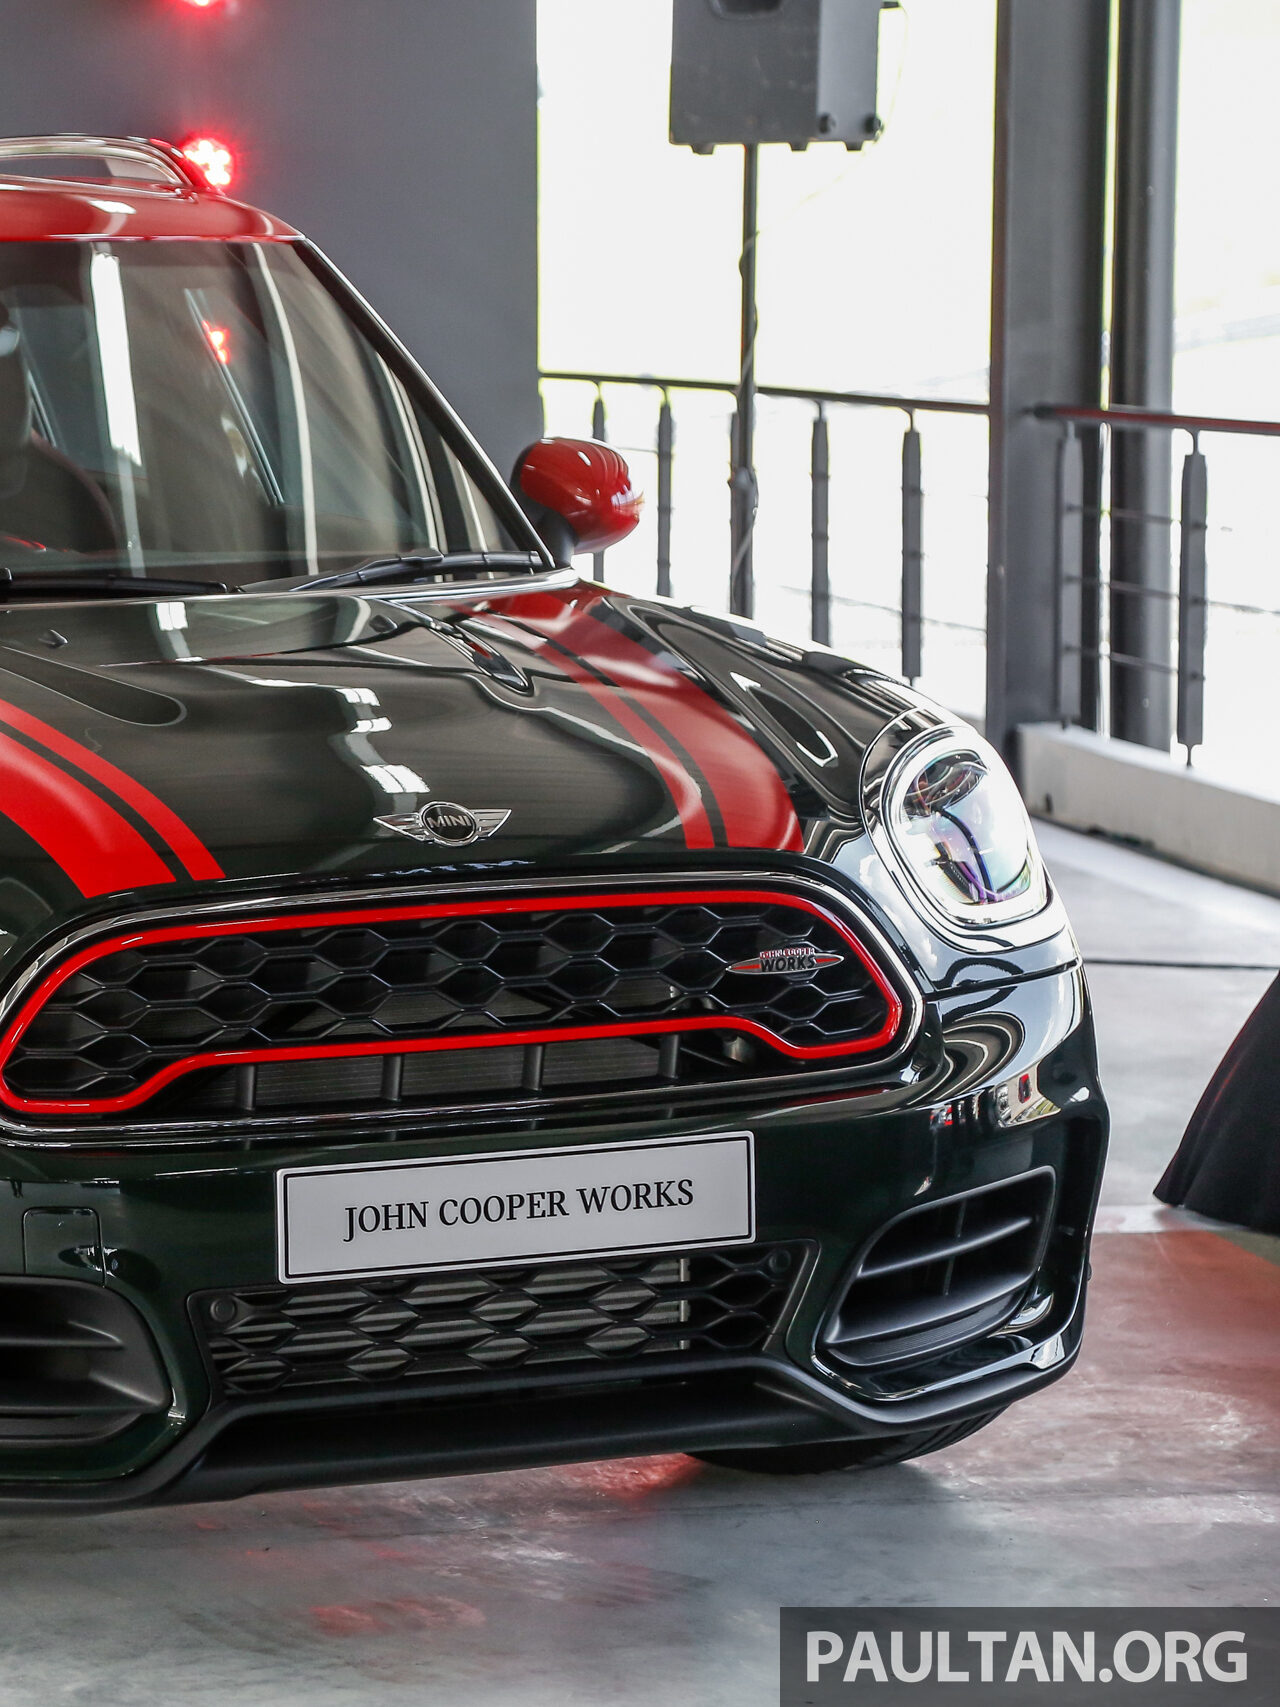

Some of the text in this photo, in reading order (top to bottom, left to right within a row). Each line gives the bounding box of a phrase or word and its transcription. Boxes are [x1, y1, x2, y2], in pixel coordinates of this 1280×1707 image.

[427, 815, 471, 828] MINI
[760, 955, 817, 972] WORKS
[343, 1178, 694, 1243] JOHN COOPER WORKS
